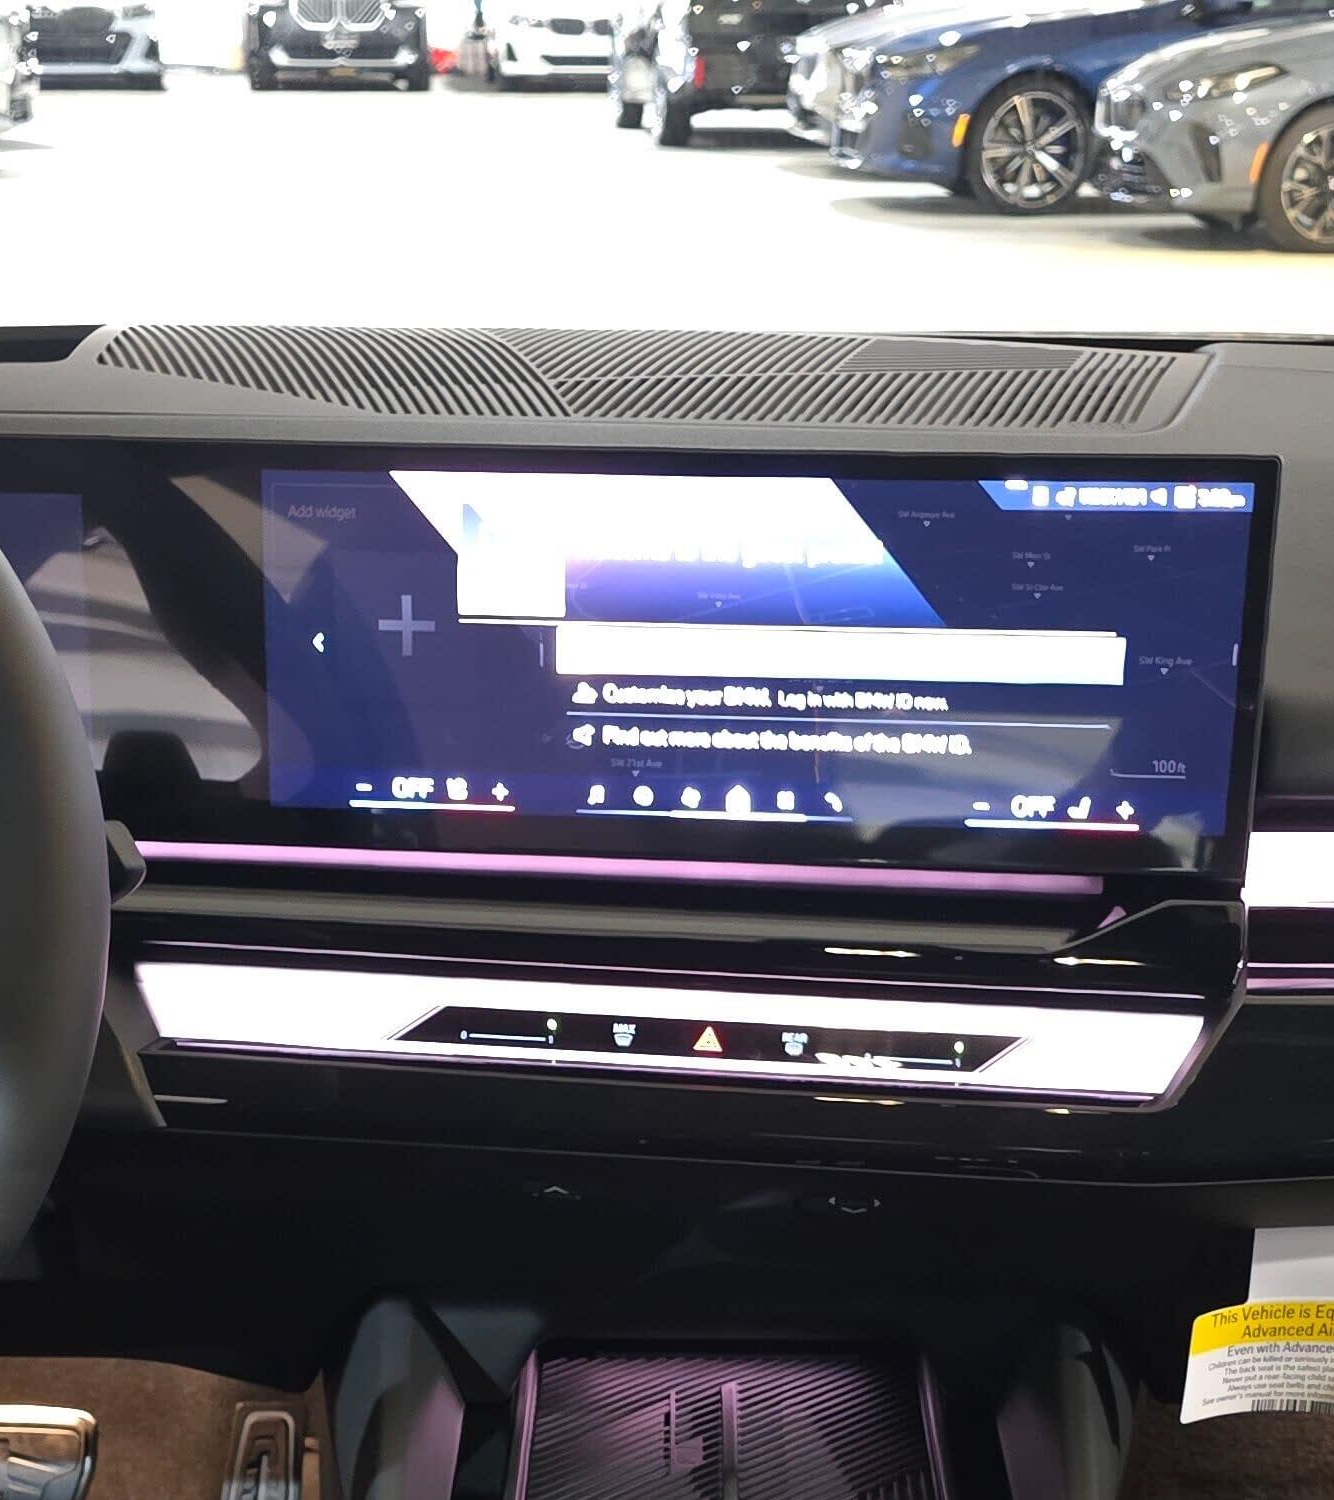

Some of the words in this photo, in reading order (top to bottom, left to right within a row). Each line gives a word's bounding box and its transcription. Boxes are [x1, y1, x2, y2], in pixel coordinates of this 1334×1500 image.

[287, 505, 313, 518] Add
[315, 505, 357, 522] widget
[1152, 760, 1176, 774] 100
[391, 776, 435, 800] OFF
[1010, 794, 1057, 819] OFF
[612, 1022, 637, 1035] MAX
[1212, 1312, 1238, 1328] This
[1241, 1305, 1295, 1321] Vehicle
[1298, 1304, 1311, 1319] is
[1242, 1323, 1314, 1339] Advanced
[1227, 1345, 1254, 1357] Even
[1256, 1342, 1281, 1354] with
